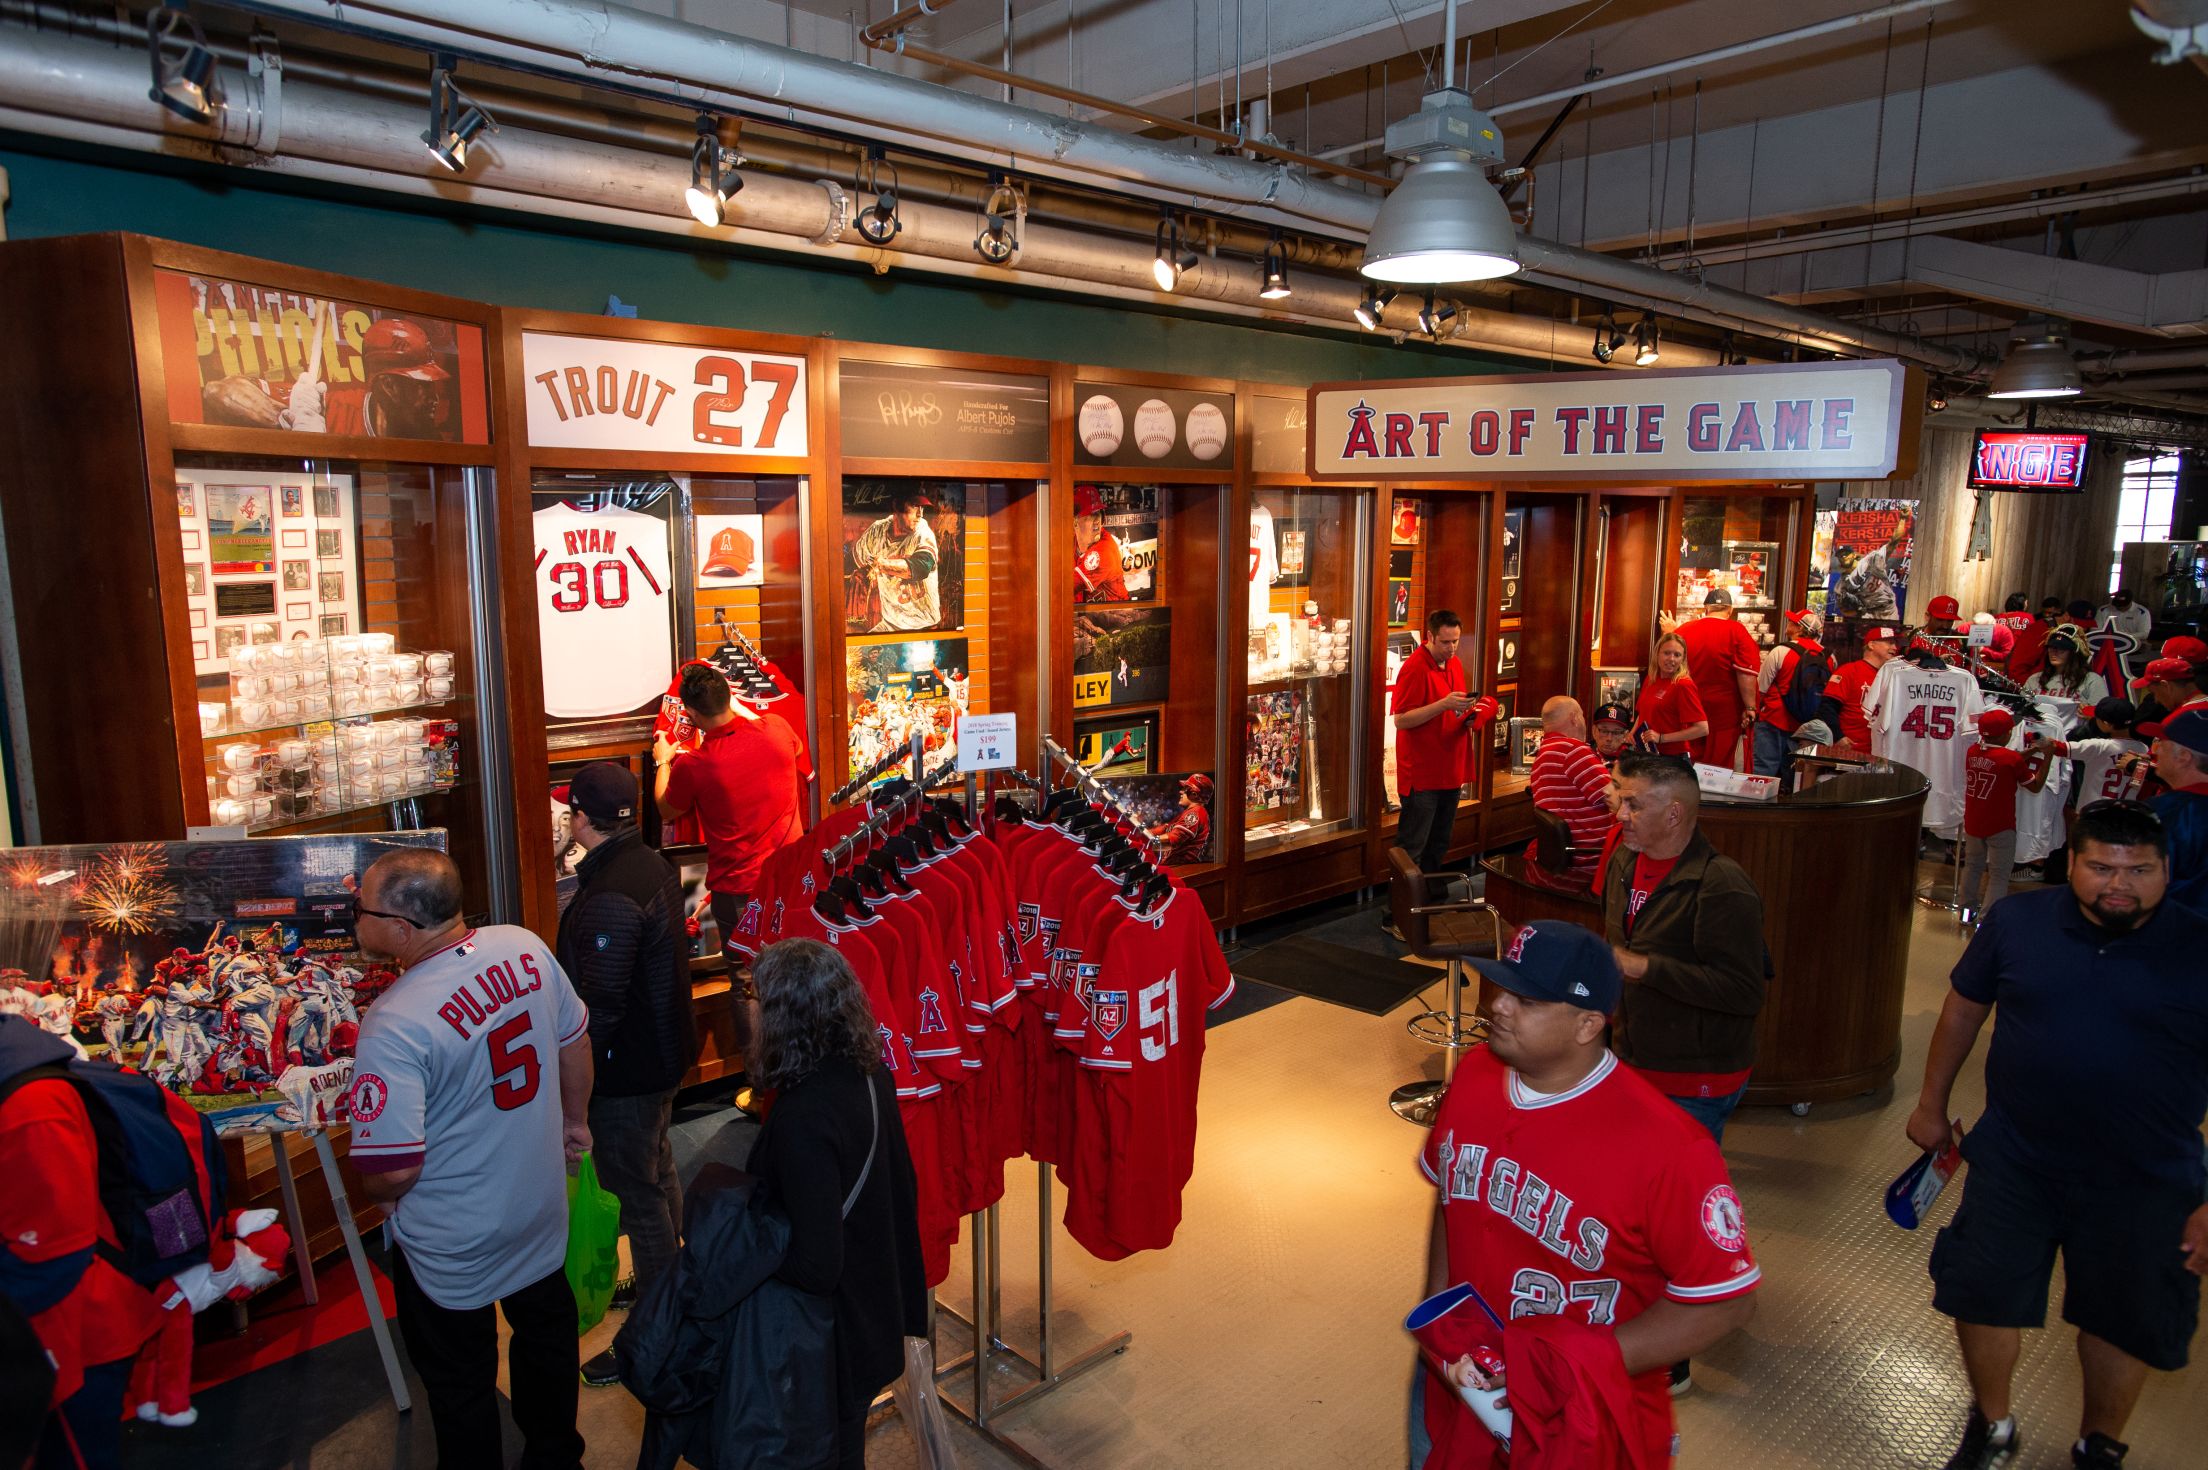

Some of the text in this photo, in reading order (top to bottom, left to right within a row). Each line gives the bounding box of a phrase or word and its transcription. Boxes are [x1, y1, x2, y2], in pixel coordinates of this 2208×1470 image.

[535, 356, 798, 448] TROUT 27
[956, 409, 1016, 427] Albert Pujols
[1339, 397, 1856, 460] ART OF THE GAME
[1974, 441, 2086, 487] NGE
[563, 528, 616, 556] RYAN
[1840, 527, 1893, 539] KERSHA
[549, 559, 630, 613] 30
[1076, 680, 1109, 699] LEY
[1602, 678, 1617, 686] LIFE
[1907, 683, 1956, 701] SKAGGS
[1901, 704, 1957, 741] 45
[980, 735, 996, 743] $199
[1967, 770, 1997, 799] 27
[1046, 922, 1060, 930] 2018
[437, 953, 542, 1041] PUJOLS
[1086, 984, 1096, 994] A
[1109, 992, 1126, 1002] 2018
[1102, 1011, 1117, 1021] AZ
[1138, 968, 1179, 1062] 51
[487, 1009, 542, 1111] 5
[1437, 1129, 1609, 1272] ANGELS
[1511, 1267, 1621, 1325] 27
